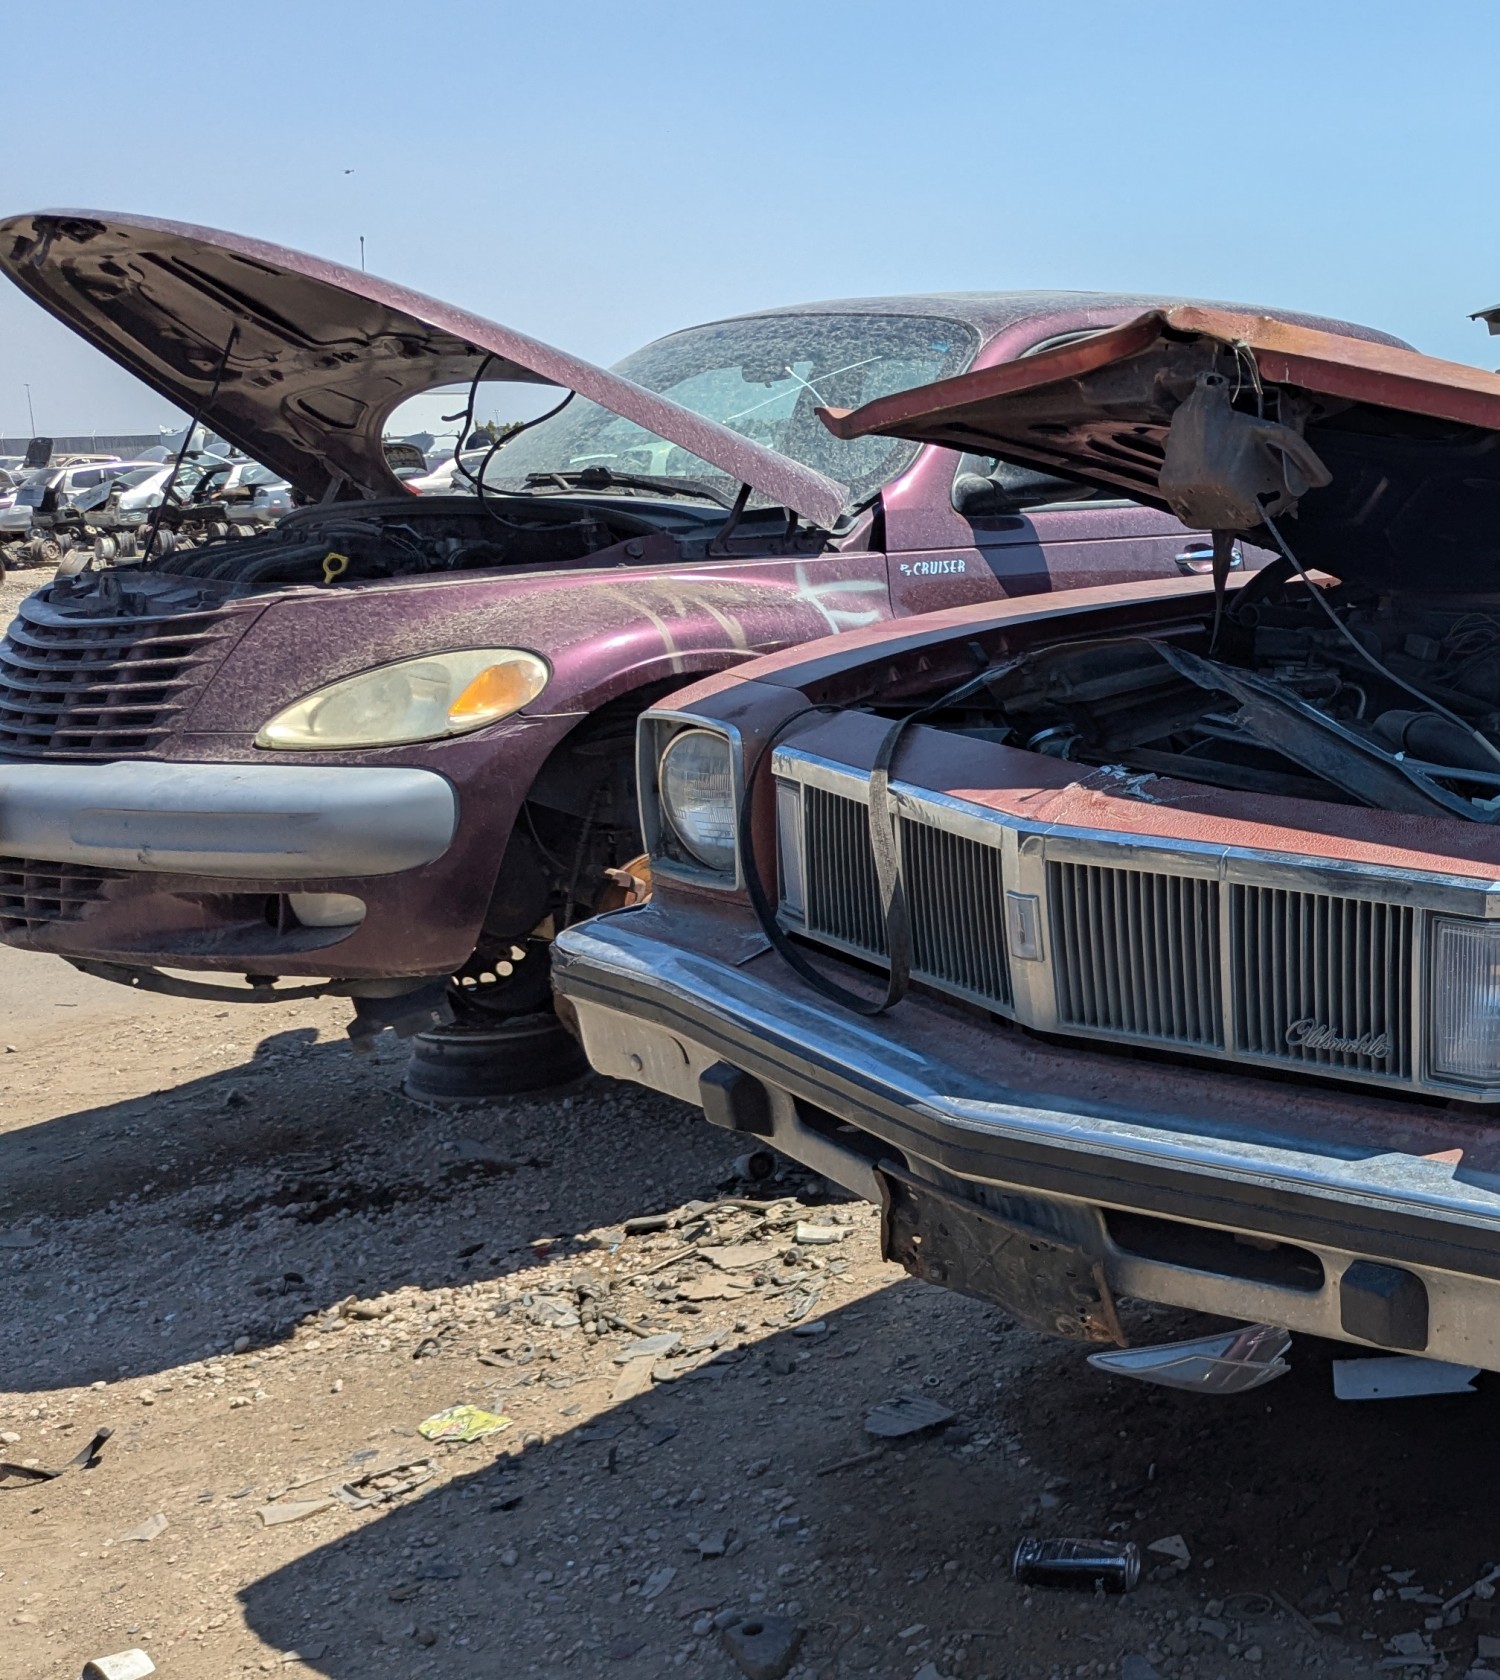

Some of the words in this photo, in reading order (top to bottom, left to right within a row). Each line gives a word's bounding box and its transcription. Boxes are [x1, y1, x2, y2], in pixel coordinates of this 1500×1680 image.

[899, 563, 913, 577] PT
[913, 559, 966, 576] CRUISER
[1285, 1017, 1392, 1059] Oldsmobile
